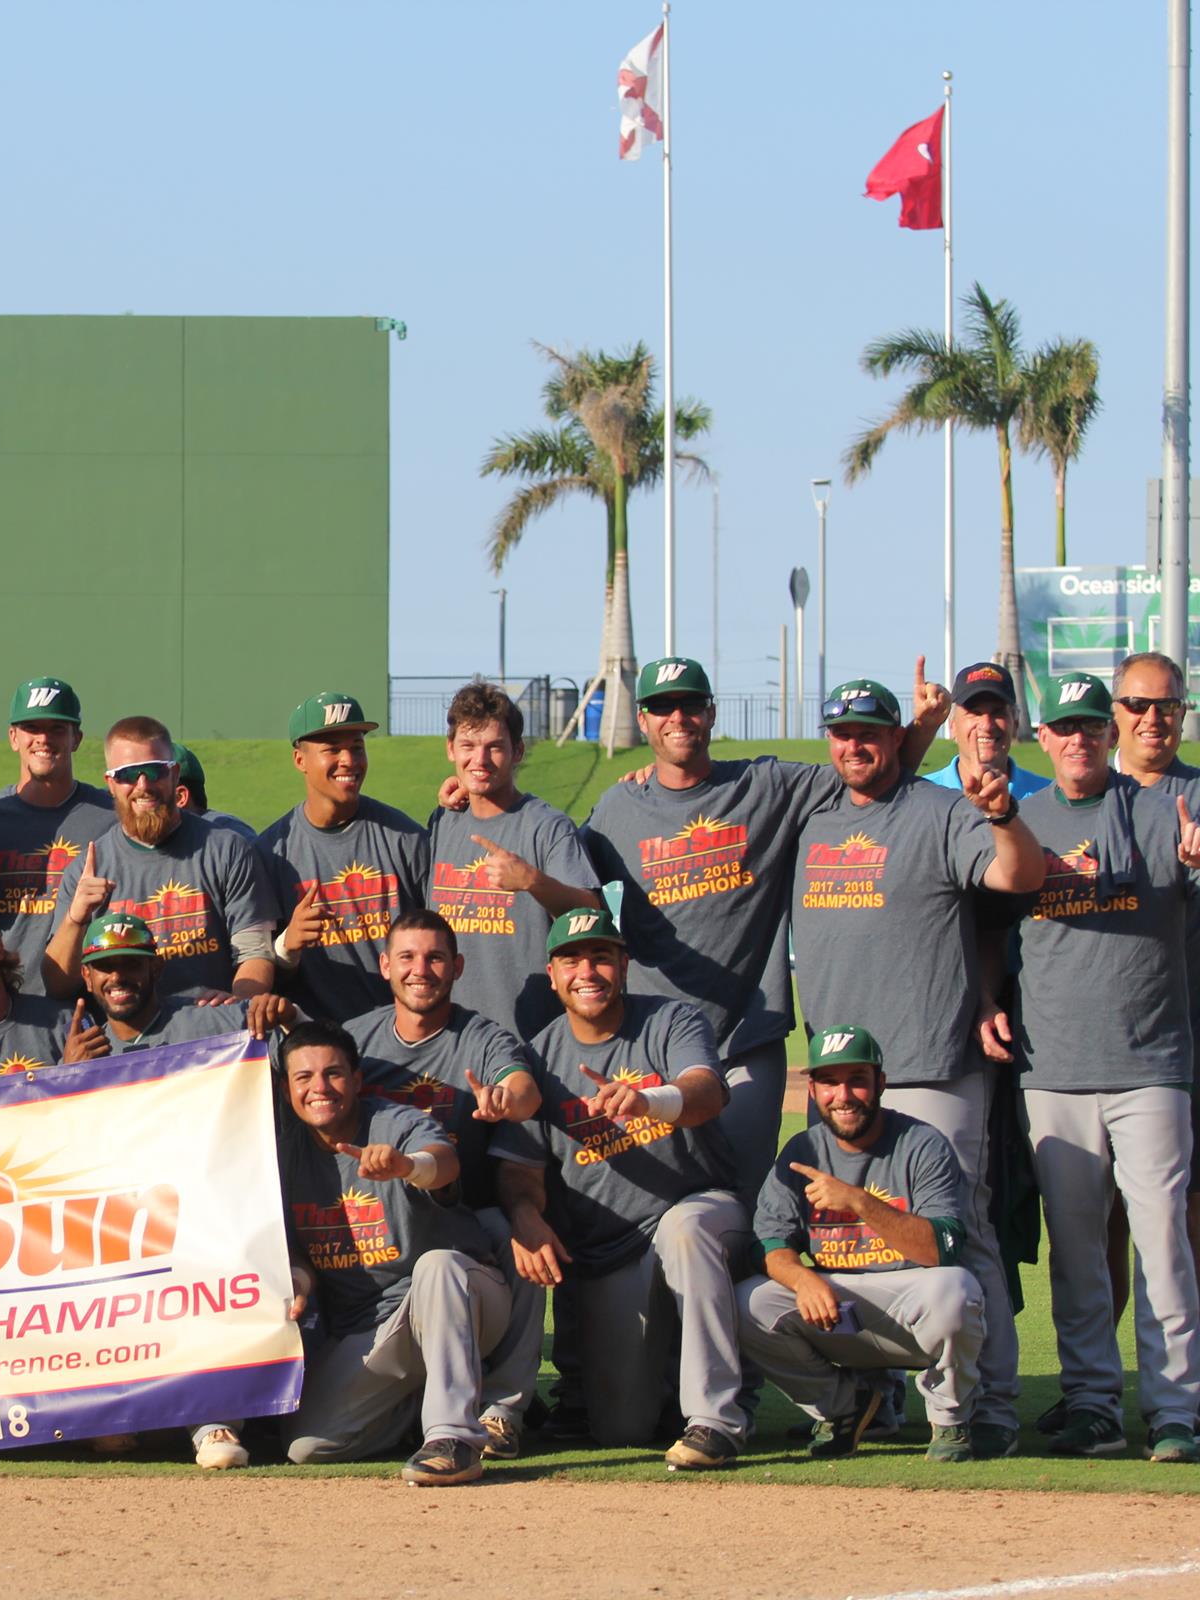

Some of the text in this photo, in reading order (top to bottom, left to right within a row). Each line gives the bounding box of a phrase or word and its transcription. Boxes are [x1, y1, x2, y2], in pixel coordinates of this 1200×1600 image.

[655, 663, 688, 686] W
[27, 687, 61, 709] W
[1059, 682, 1092, 705] W
[323, 703, 352, 726] W
[638, 825, 747, 863] The Sun
[654, 872, 689, 889] 2017
[703, 861, 740, 879] 2018
[5, 888, 38, 899] 2017
[648, 871, 753, 906] CHAMPIONS
[809, 881, 834, 893] 2017
[844, 881, 873, 893] 2018
[1039, 889, 1075, 904] 2017
[803, 893, 885, 909] CHAMPIONS
[439, 904, 465, 917] 2017
[477, 907, 506, 919] 2018
[445, 917, 515, 934] AMPIONS
[567, 915, 599, 936] W
[171, 928, 207, 945] 2018
[820, 1033, 855, 1056] W
[355, 1237, 385, 1252] 018
[821, 1240, 857, 1253] 2017
